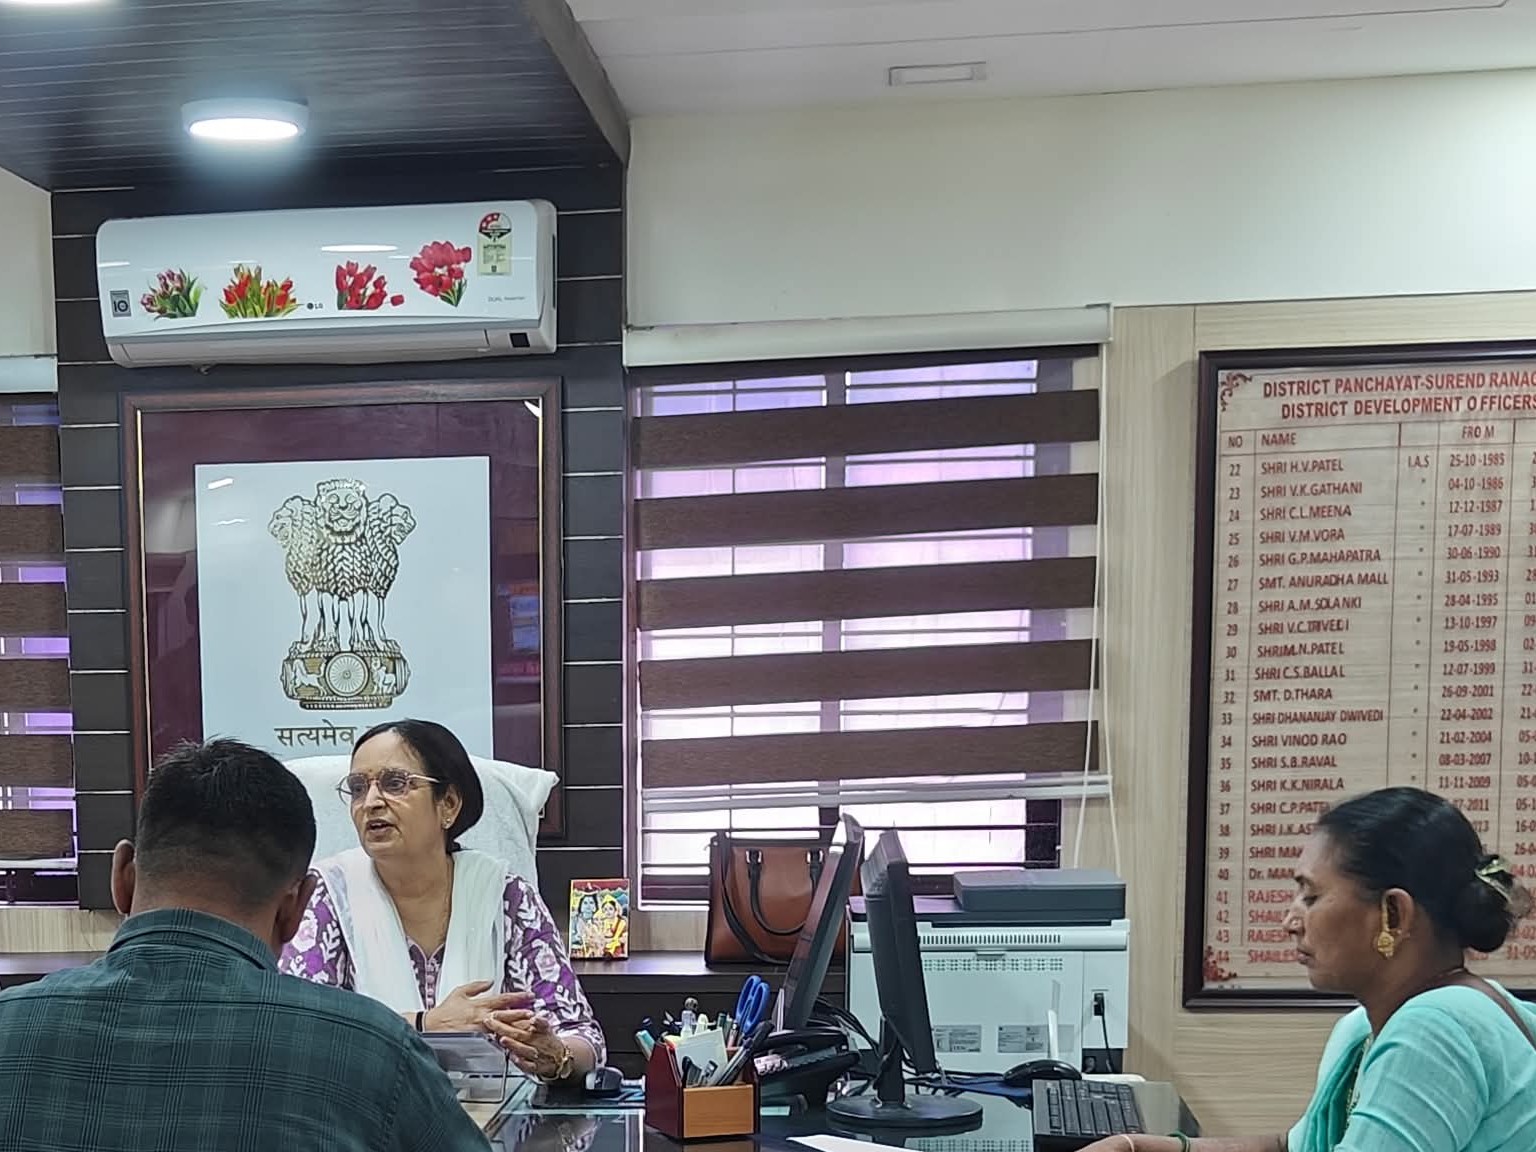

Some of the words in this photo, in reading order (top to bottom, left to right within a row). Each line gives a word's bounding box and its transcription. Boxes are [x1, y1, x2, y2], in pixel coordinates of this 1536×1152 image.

[1264, 380, 1330, 398] DISTRICT
[1282, 401, 1348, 419] DISTRICT
[1354, 396, 1462, 416] DEVELOPMENT
[1228, 436, 1242, 448] NO
[1261, 433, 1296, 446] NAME
[1229, 464, 1240, 476] 22
[1261, 462, 1287, 475] SHRI
[1290, 460, 1344, 473] H.V.PATEL
[1229, 488, 1240, 500] 23
[1260, 486, 1286, 498] SHRI
[1290, 482, 1362, 496] V.K.GATHANI
[1228, 510, 1240, 522] 24
[1260, 508, 1286, 520] SHRI
[1289, 505, 1352, 518] C.L.MEENA
[1228, 533, 1240, 545] 25
[1260, 532, 1284, 544] SHRI
[1288, 528, 1344, 542] V.M.VORA
[1228, 555, 1239, 568] 26
[1259, 554, 1284, 566] SHRI
[1288, 549, 1381, 564] G.P.MAHAPATRA
[1227, 579, 1238, 591] 27
[1258, 576, 1285, 590] SMT.
[1289, 574, 1354, 588] ANURADHA
[1358, 572, 1389, 584] MALL
[1227, 602, 1238, 614] 28
[1258, 600, 1284, 613] SHRI
[1226, 624, 1238, 636] 29
[1258, 622, 1284, 635] SHRI
[1226, 646, 1236, 658] 30
[1225, 669, 1236, 682] 31
[1254, 668, 1280, 680] SHRI
[1283, 666, 1346, 679] C.S.BALLAL
[1224, 692, 1235, 704] 32
[1254, 690, 1280, 702] SMT.
[1284, 688, 1332, 701] D.THARA
[1222, 712, 1232, 725] 33
[1252, 712, 1275, 725] SHRI
[1278, 710, 1336, 724] DHANANJAY
[1340, 709, 1384, 722] DWIVEDI
[274, 719, 357, 747] सत्यमेव
[1220, 736, 1232, 748] 34
[1252, 735, 1278, 748] SHRI
[1280, 734, 1318, 746] VINOD
[1321, 733, 1347, 746] RAO
[1220, 758, 1231, 770] 35
[1252, 756, 1277, 769] SHRI
[1280, 756, 1338, 768] S.B.RAVAL
[1220, 780, 1231, 792] 36
[1250, 780, 1276, 792] SHRI
[1280, 778, 1344, 792] K.K.NIRALA
[1219, 803, 1230, 816] 37
[1250, 802, 1276, 815] SHRI
[1219, 824, 1230, 836] 38
[1250, 824, 1276, 836] SHRI
[1218, 848, 1230, 860] 39
[1250, 846, 1276, 858] SHRI
[1248, 868, 1264, 880] Dr.
[1216, 890, 1228, 904] 41
[1216, 910, 1229, 923] 42
[1216, 930, 1230, 942] 43
